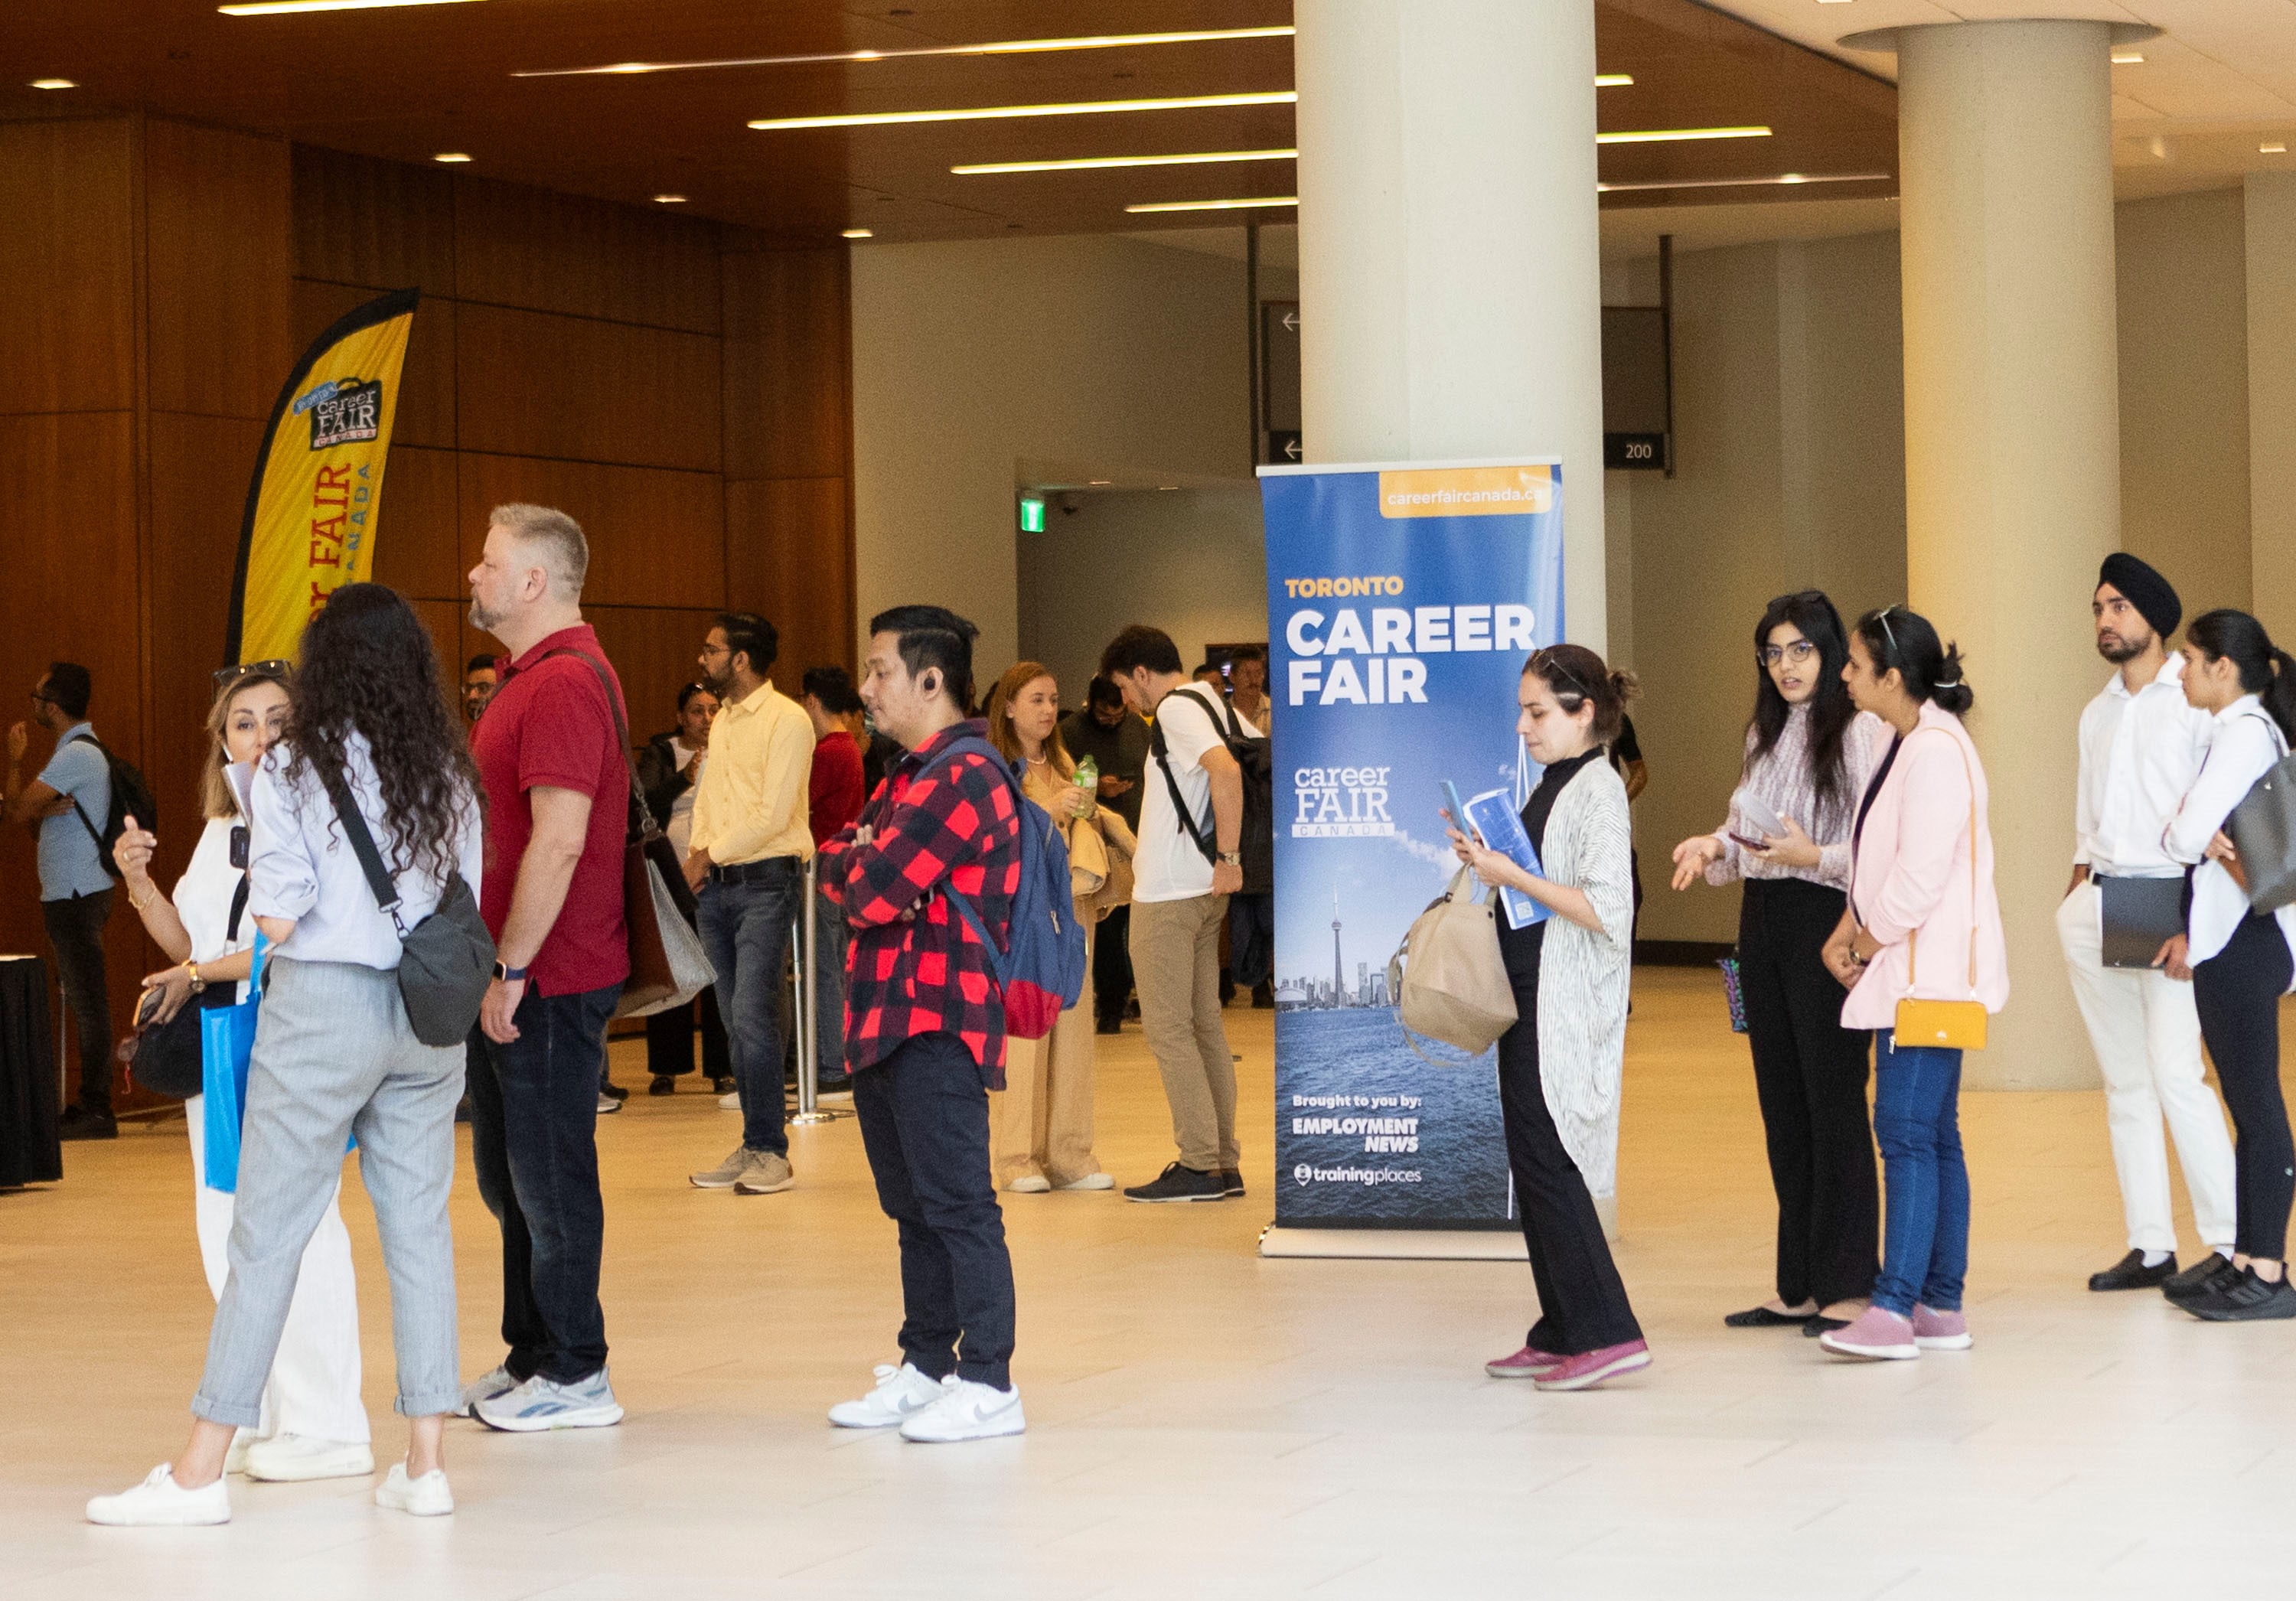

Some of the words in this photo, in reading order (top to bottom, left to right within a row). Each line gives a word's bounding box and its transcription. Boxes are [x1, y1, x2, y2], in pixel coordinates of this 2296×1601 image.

[318, 390, 377, 415] career
[318, 404, 377, 439] FAIR
[1626, 444, 1652, 458] 200
[1388, 487, 1542, 505] careerfaircanada.c
[309, 462, 351, 568] FAIR
[1284, 576, 1404, 598] TORONTO
[1286, 604, 1535, 657] CAREER
[1288, 658, 1428, 706] FAIR
[1294, 767, 1391, 787] career
[1294, 787, 1392, 823] FAIR
[1300, 825, 1386, 836] CANADA
[1293, 1094, 1351, 1109] Brought
[1353, 1096, 1368, 1107] to
[1371, 1097, 1397, 1109] you
[1400, 1095, 1422, 1109] by:
[1292, 1118, 1418, 1134] EMPLOYMENT
[1364, 1136, 1419, 1153] NEWS
[1313, 1166, 1422, 1185] trainingplaces
